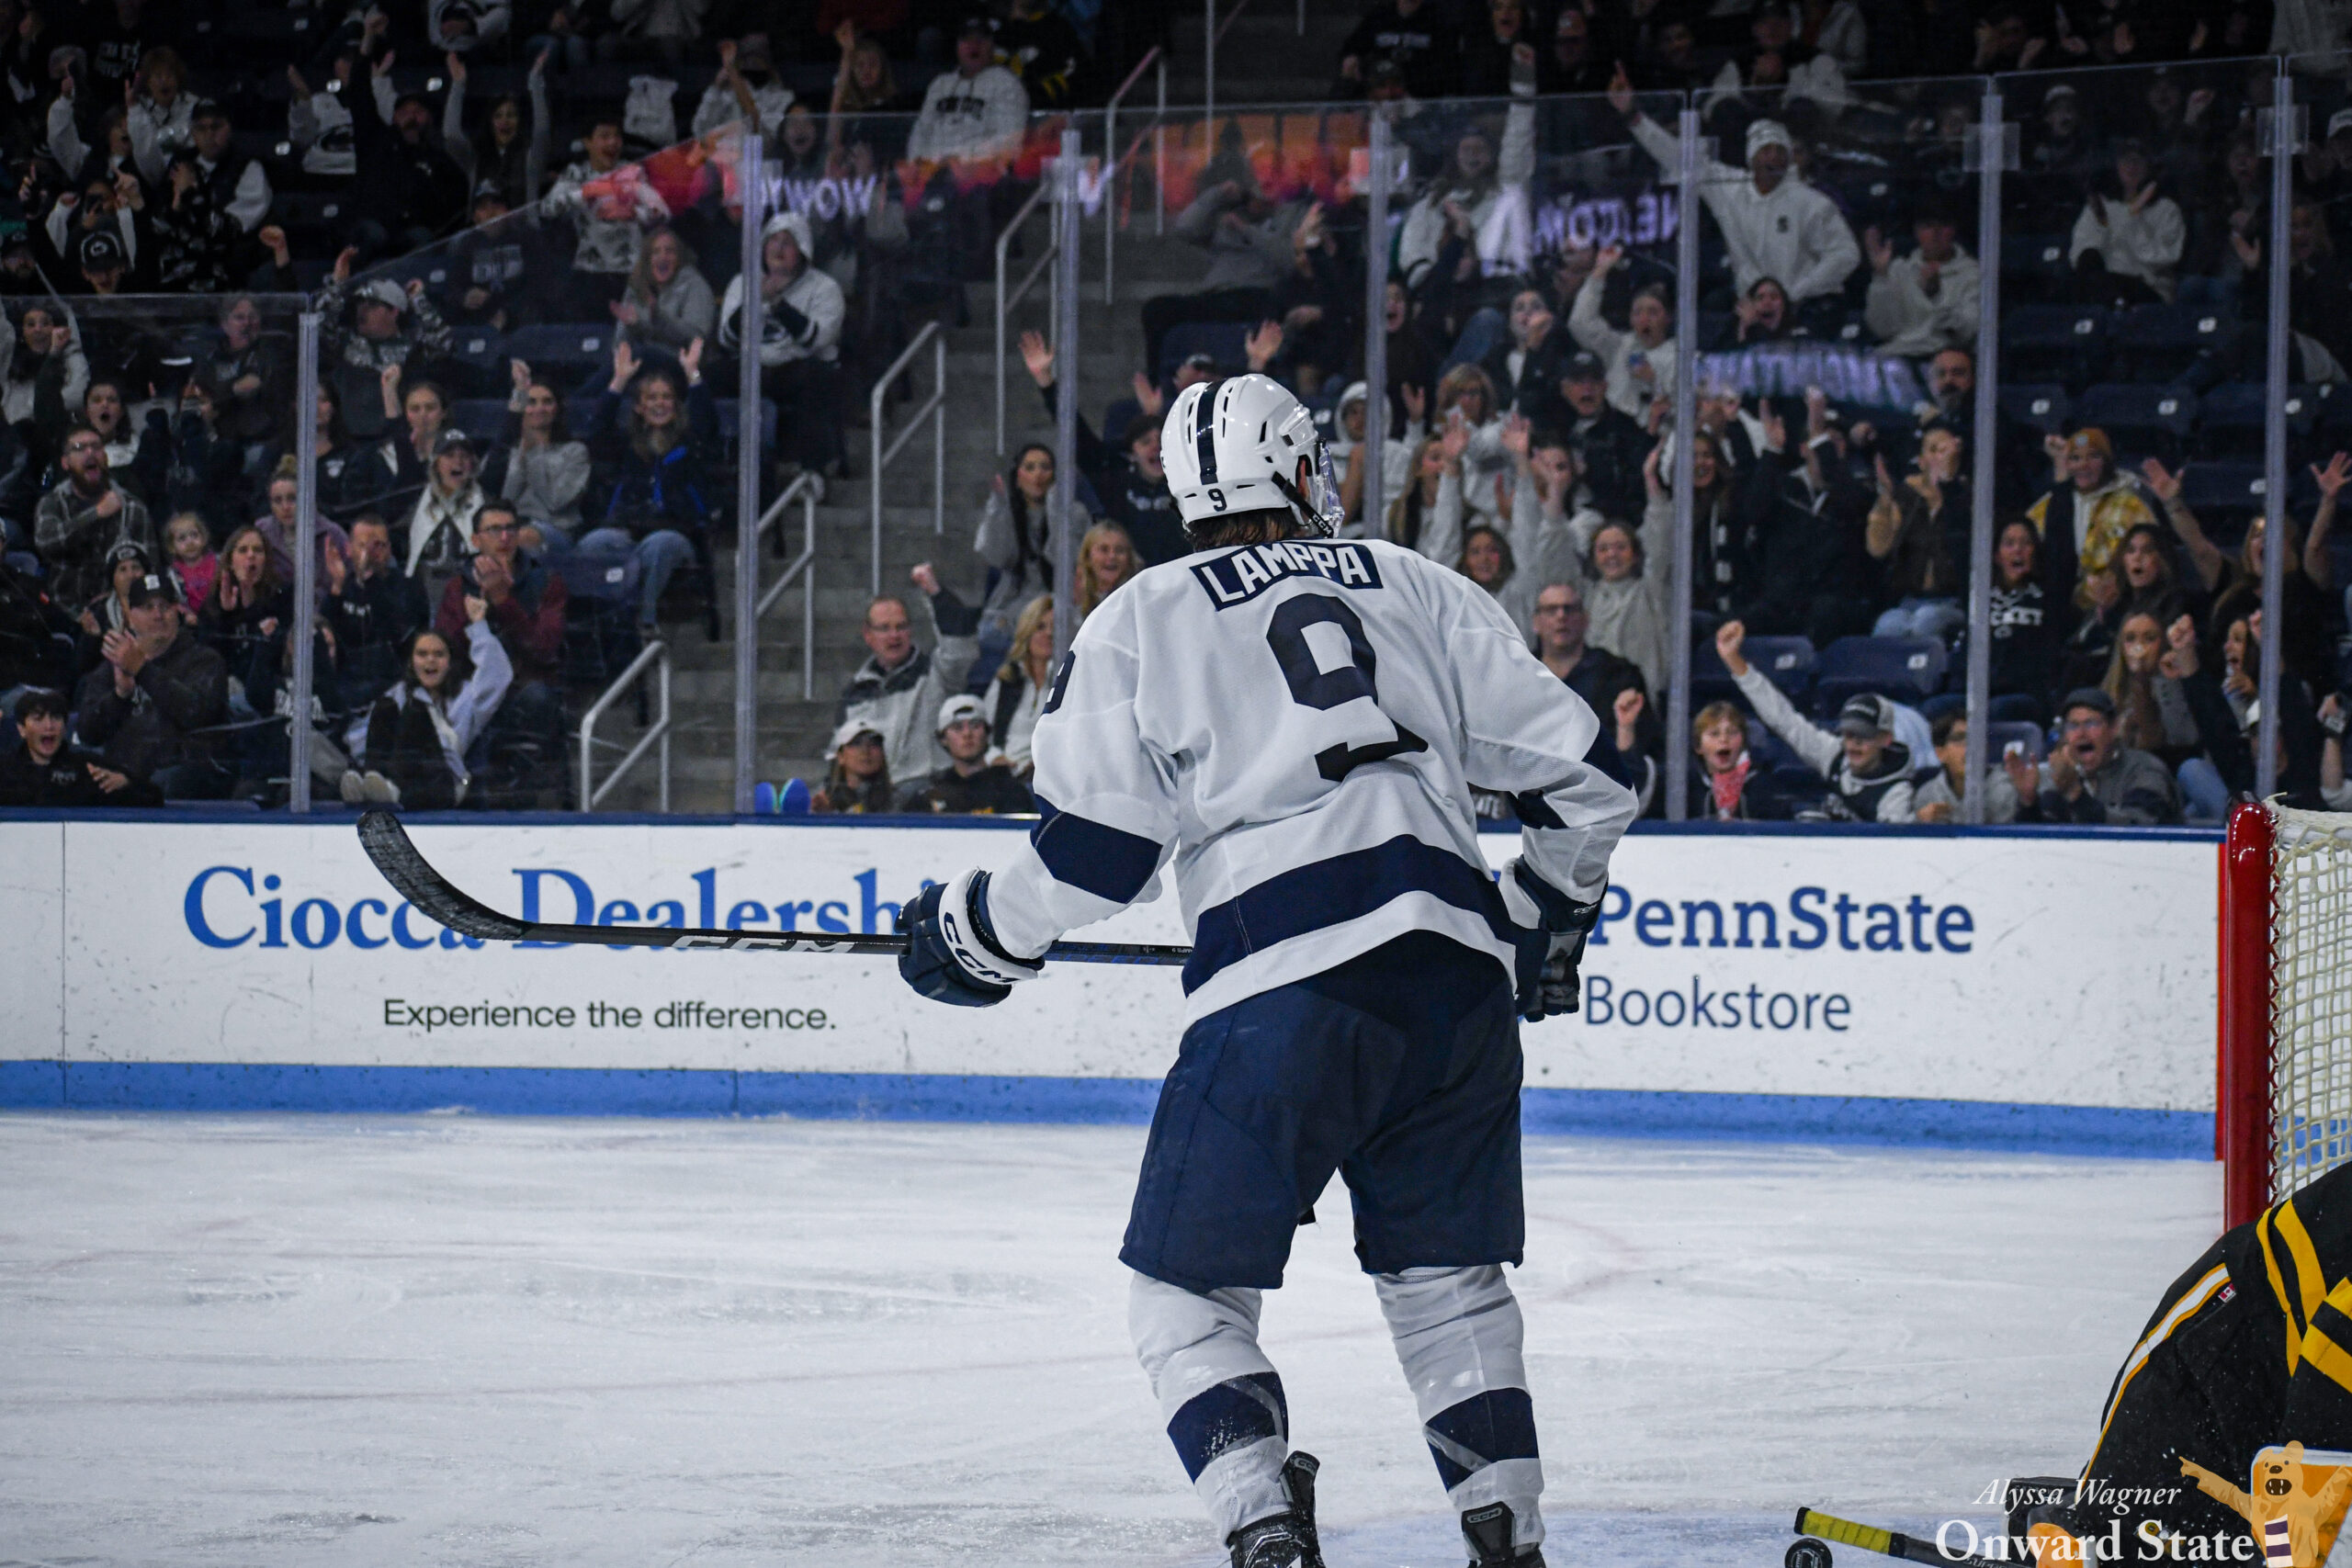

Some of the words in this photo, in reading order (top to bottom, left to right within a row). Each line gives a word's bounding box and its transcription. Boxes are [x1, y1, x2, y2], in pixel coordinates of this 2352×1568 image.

[1207, 488, 1227, 512] 9
[1312, 513, 1332, 536] CCM
[1200, 543, 1372, 604] LAMPPA
[1266, 592, 1429, 783] 9
[513, 868, 942, 950] Dealersh
[1588, 886, 1973, 953] PennState
[672, 934, 855, 954] CCM
[944, 911, 1022, 983] CCM
[384, 999, 575, 1033] Experience
[587, 1001, 642, 1028] the
[654, 1001, 835, 1030] difference.
[1587, 976, 1851, 1032] Bookstore
[1469, 1507, 1499, 1522] CCM
